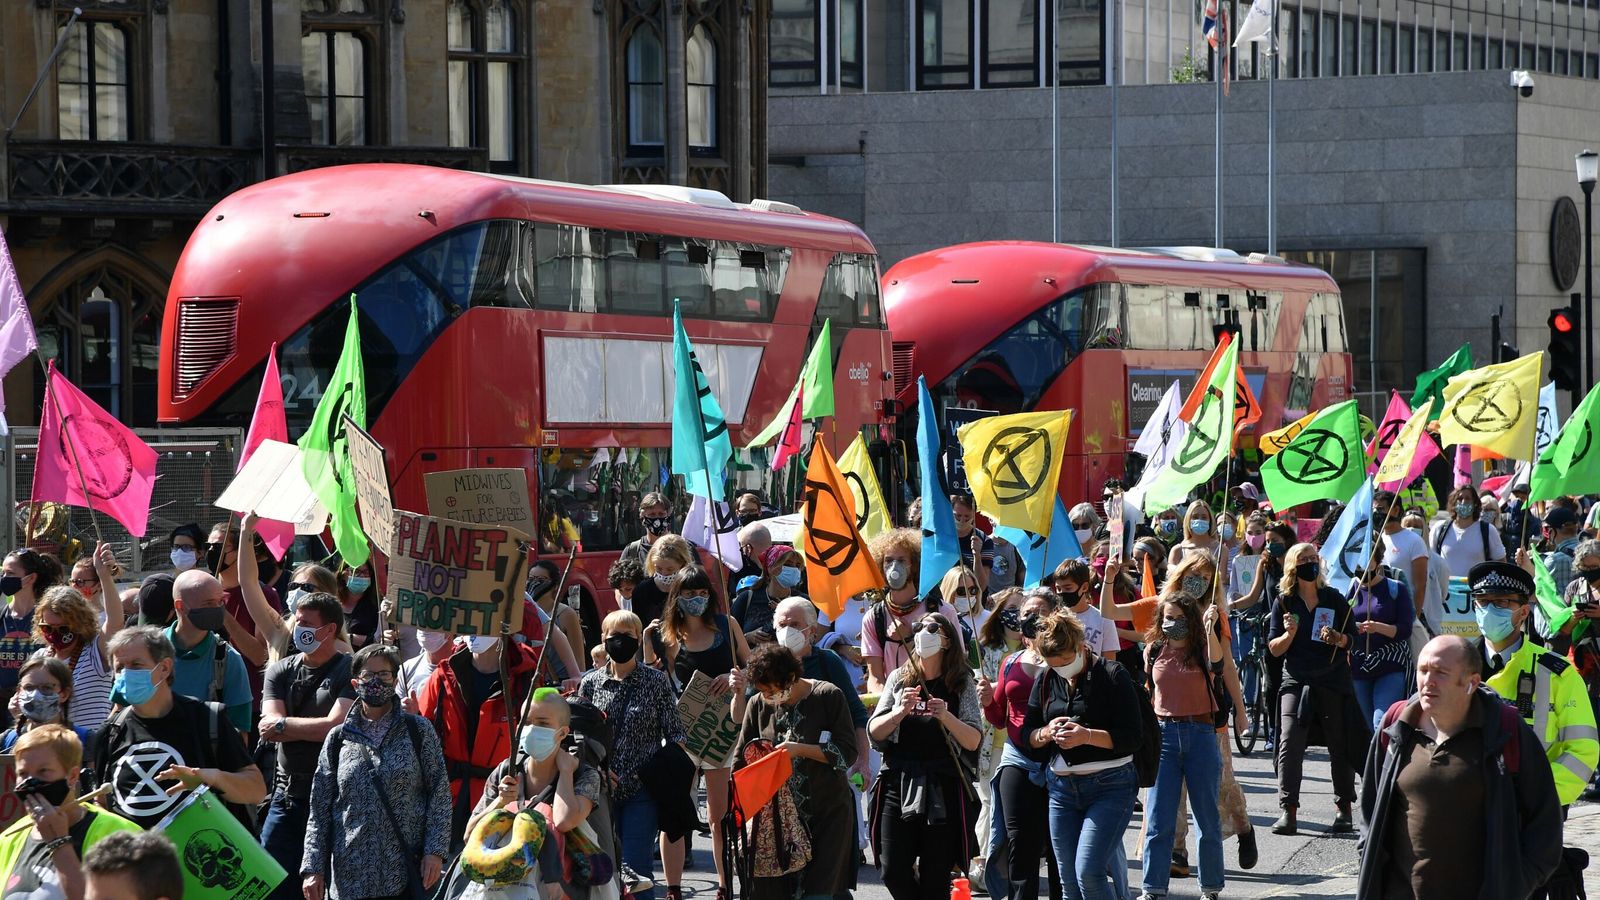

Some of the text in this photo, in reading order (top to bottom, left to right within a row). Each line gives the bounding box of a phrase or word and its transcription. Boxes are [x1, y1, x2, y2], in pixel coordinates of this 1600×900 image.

[280, 374, 323, 409] 24
[454, 473, 513, 493] MIDWIVES
[476, 493, 495, 506] FOR
[396, 515, 508, 572] PLANET
[413, 561, 468, 598] NOT
[395, 588, 499, 636] PROFIT
[687, 710, 719, 756] AVOID
